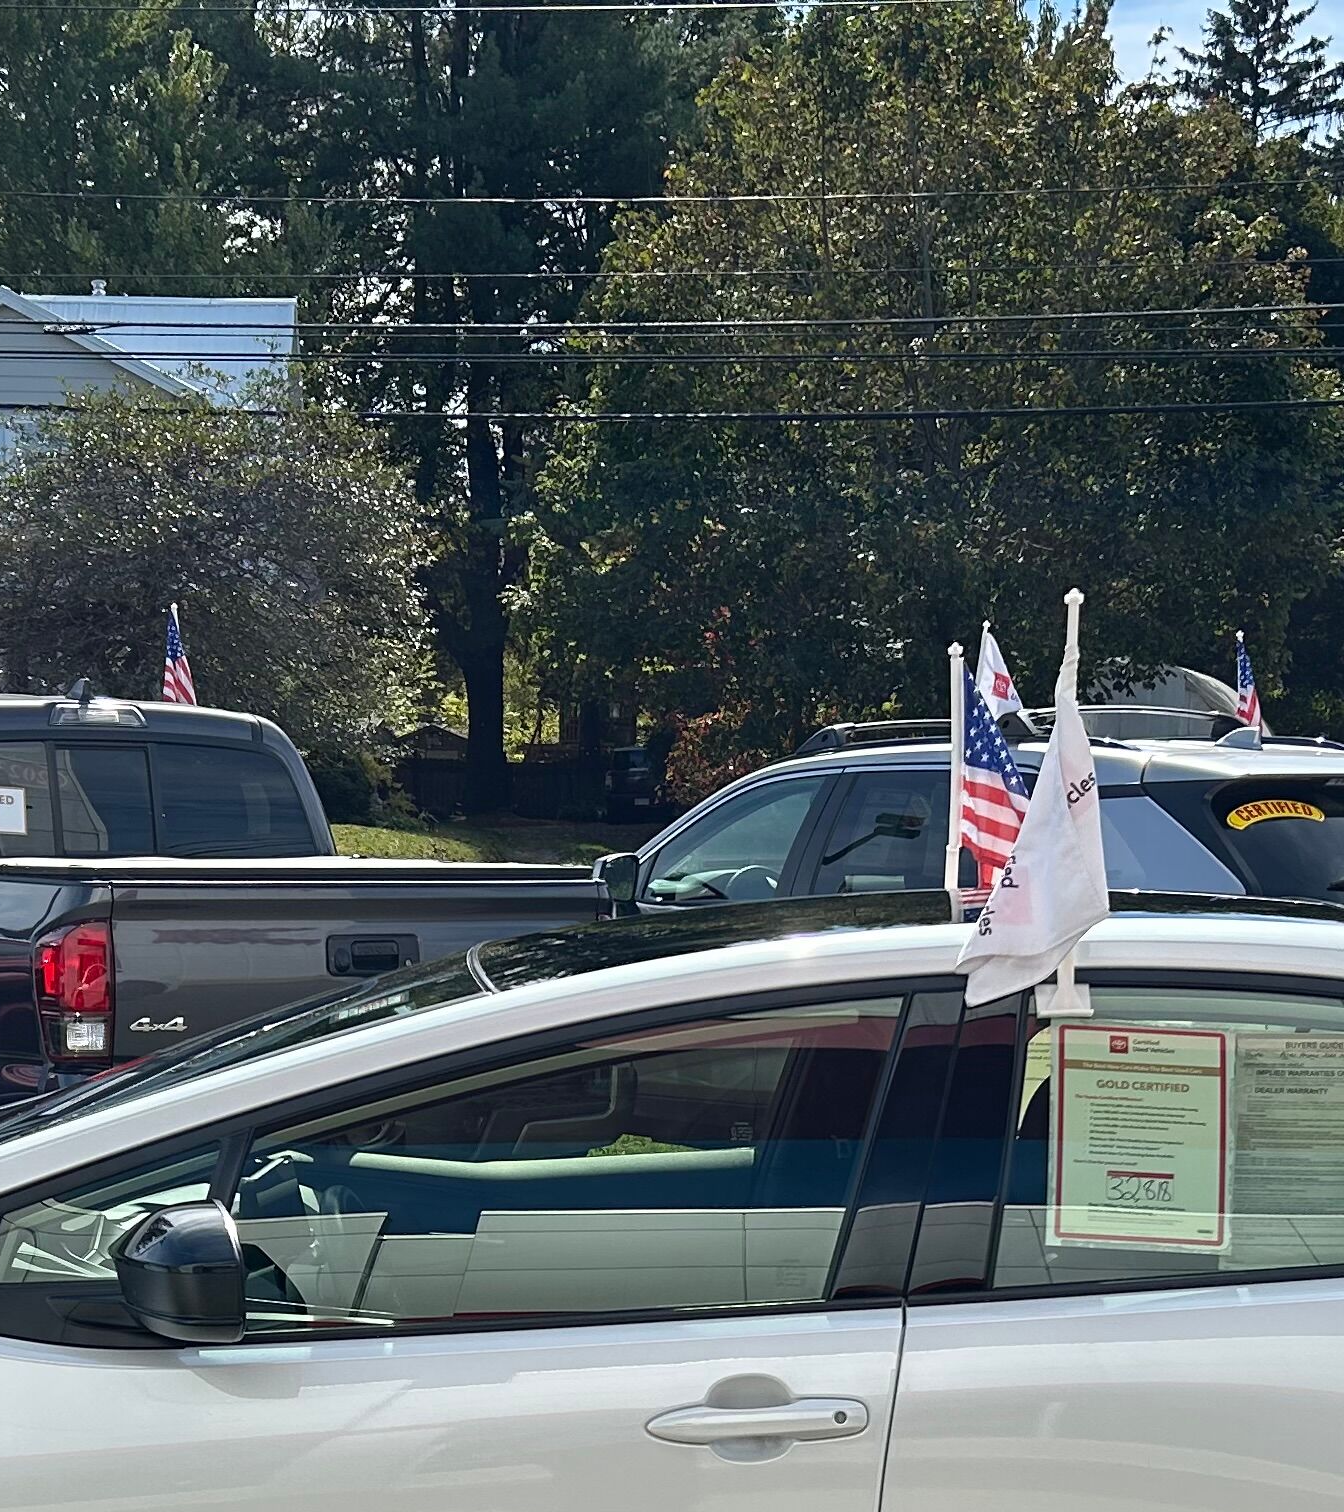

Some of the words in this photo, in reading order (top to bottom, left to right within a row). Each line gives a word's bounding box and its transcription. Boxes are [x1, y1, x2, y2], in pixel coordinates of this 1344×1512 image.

[1234, 800, 1314, 822] CERTIFIED
[129, 1016, 189, 1032] 4x4
[1285, 1041, 1318, 1050] BUYERS
[1319, 1041, 1344, 1050] GUIDE
[1096, 1079, 1130, 1090] GOLD
[1131, 1080, 1190, 1093] CERTIFIED
